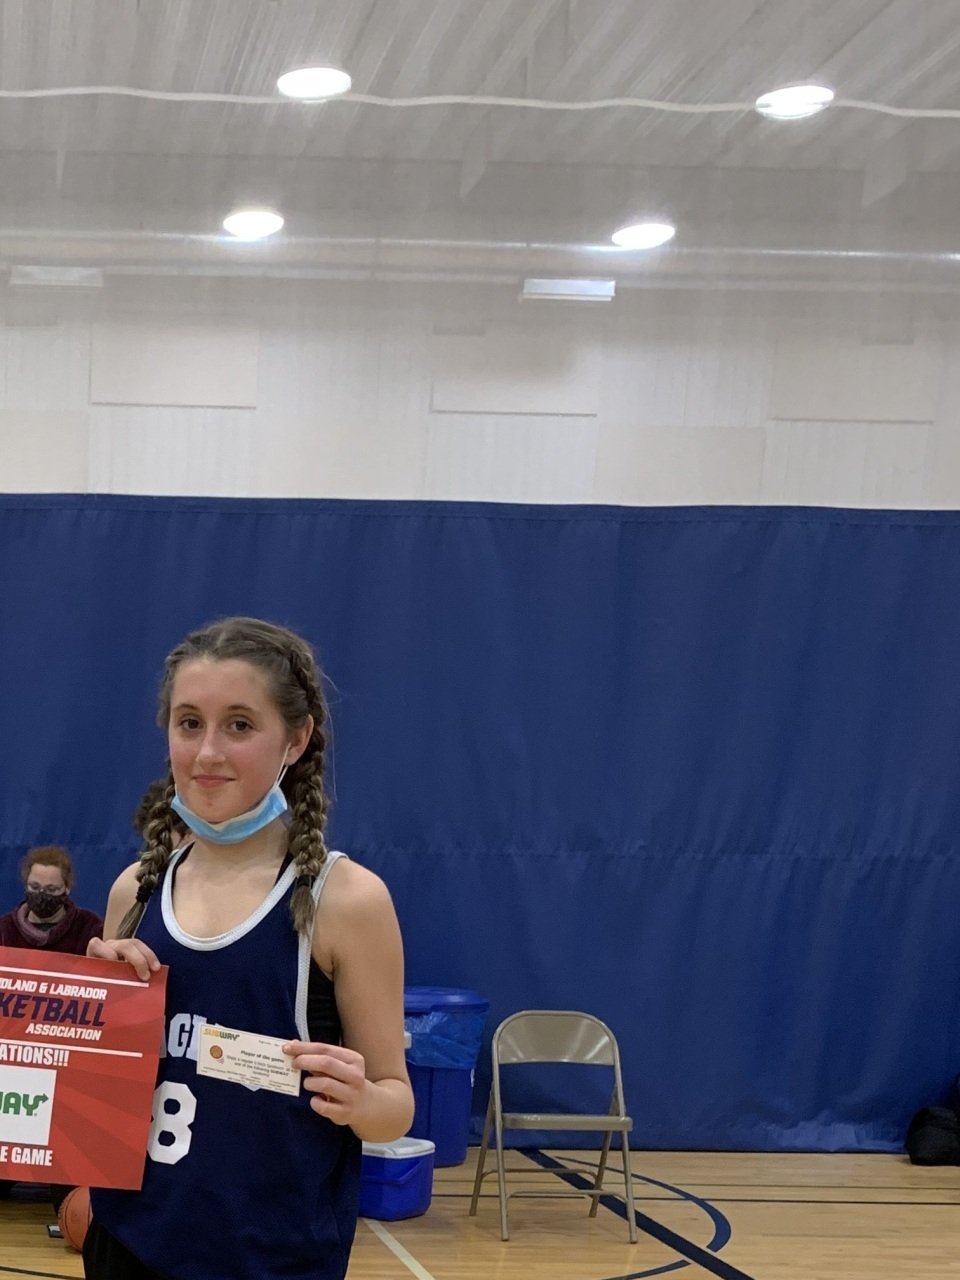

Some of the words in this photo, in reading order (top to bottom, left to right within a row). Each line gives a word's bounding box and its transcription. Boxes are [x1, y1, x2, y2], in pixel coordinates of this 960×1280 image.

[39, 983, 48, 993] &
[49, 983, 108, 1001] LABRADOR
[25, 1023, 102, 1041] ASSOCIATION
[203, 1028, 240, 1041] SUBWAY
[11, 1147, 53, 1167] GAME
